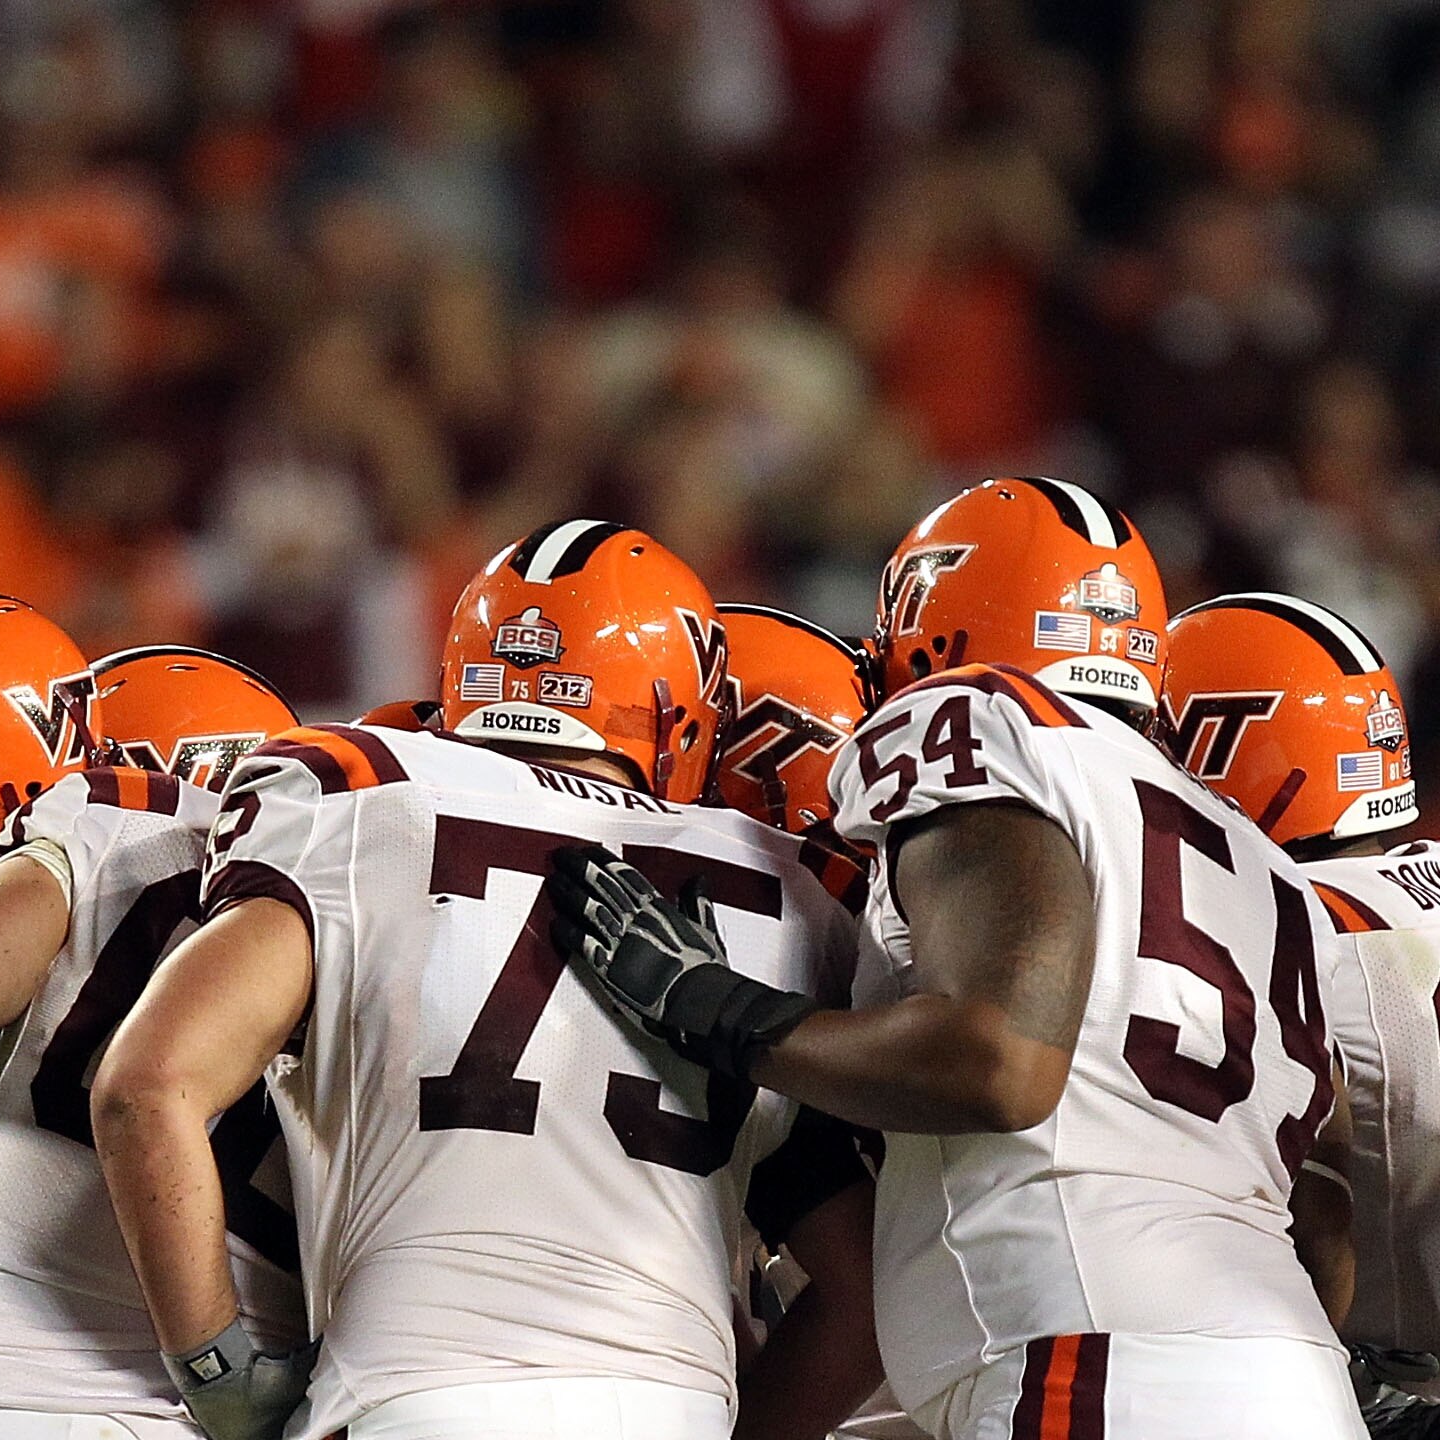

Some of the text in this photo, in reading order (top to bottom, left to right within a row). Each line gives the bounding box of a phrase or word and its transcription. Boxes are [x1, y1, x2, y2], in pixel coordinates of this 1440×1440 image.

[1087, 583, 1134, 605] BCS
[502, 628, 555, 648] BCS
[1099, 628, 1122, 652] 54
[511, 681, 529, 699] 75
[1069, 665, 1140, 691] HOKIES
[482, 712, 561, 734] HOKIES
[856, 696, 989, 825] 54
[1122, 776, 1335, 1190] 54
[418, 813, 783, 1178] 75
